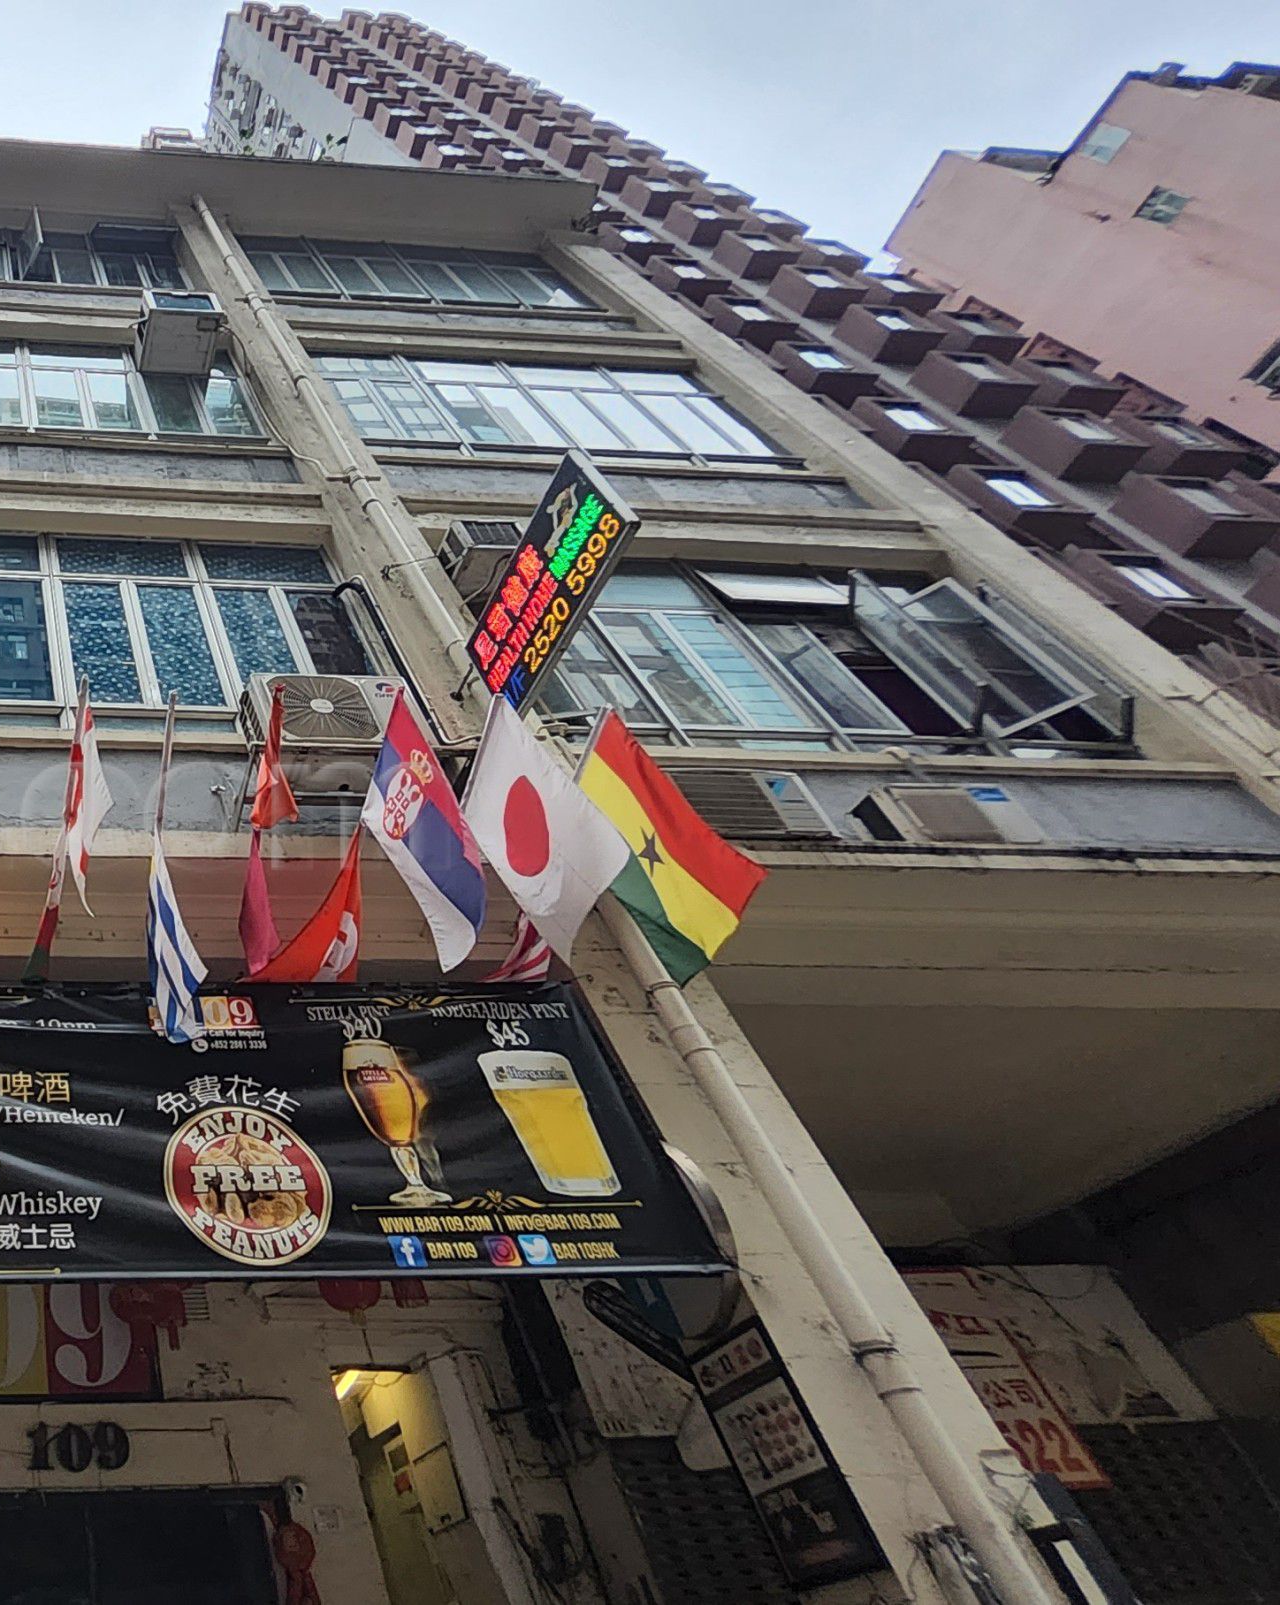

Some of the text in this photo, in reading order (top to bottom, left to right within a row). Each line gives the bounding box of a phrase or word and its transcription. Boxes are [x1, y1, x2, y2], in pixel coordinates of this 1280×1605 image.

[486, 493, 605, 693] HEALTH HOME MASSAGE
[523, 596, 570, 674] 2520
[566, 513, 620, 596] 5998
[306, 1005, 359, 1022] STELLA
[532, 1002, 572, 1020] PINT
[209, 1029, 224, 1038] Call
[238, 1029, 265, 1039] Inquiry
[485, 1019, 530, 1048] $45
[156, 1073, 301, 1126] 免費花生
[182, 1111, 294, 1154] ENJOY
[190, 1164, 307, 1193] FREE
[192, 1206, 320, 1259] PEANUTS
[379, 1215, 494, 1233] WWW.BAR109.COM
[505, 1213, 622, 1231] INFO@BAR109.COM
[426, 1241, 621, 1260] BAR109 BAR109HK
[26, 1421, 130, 1473] 109
